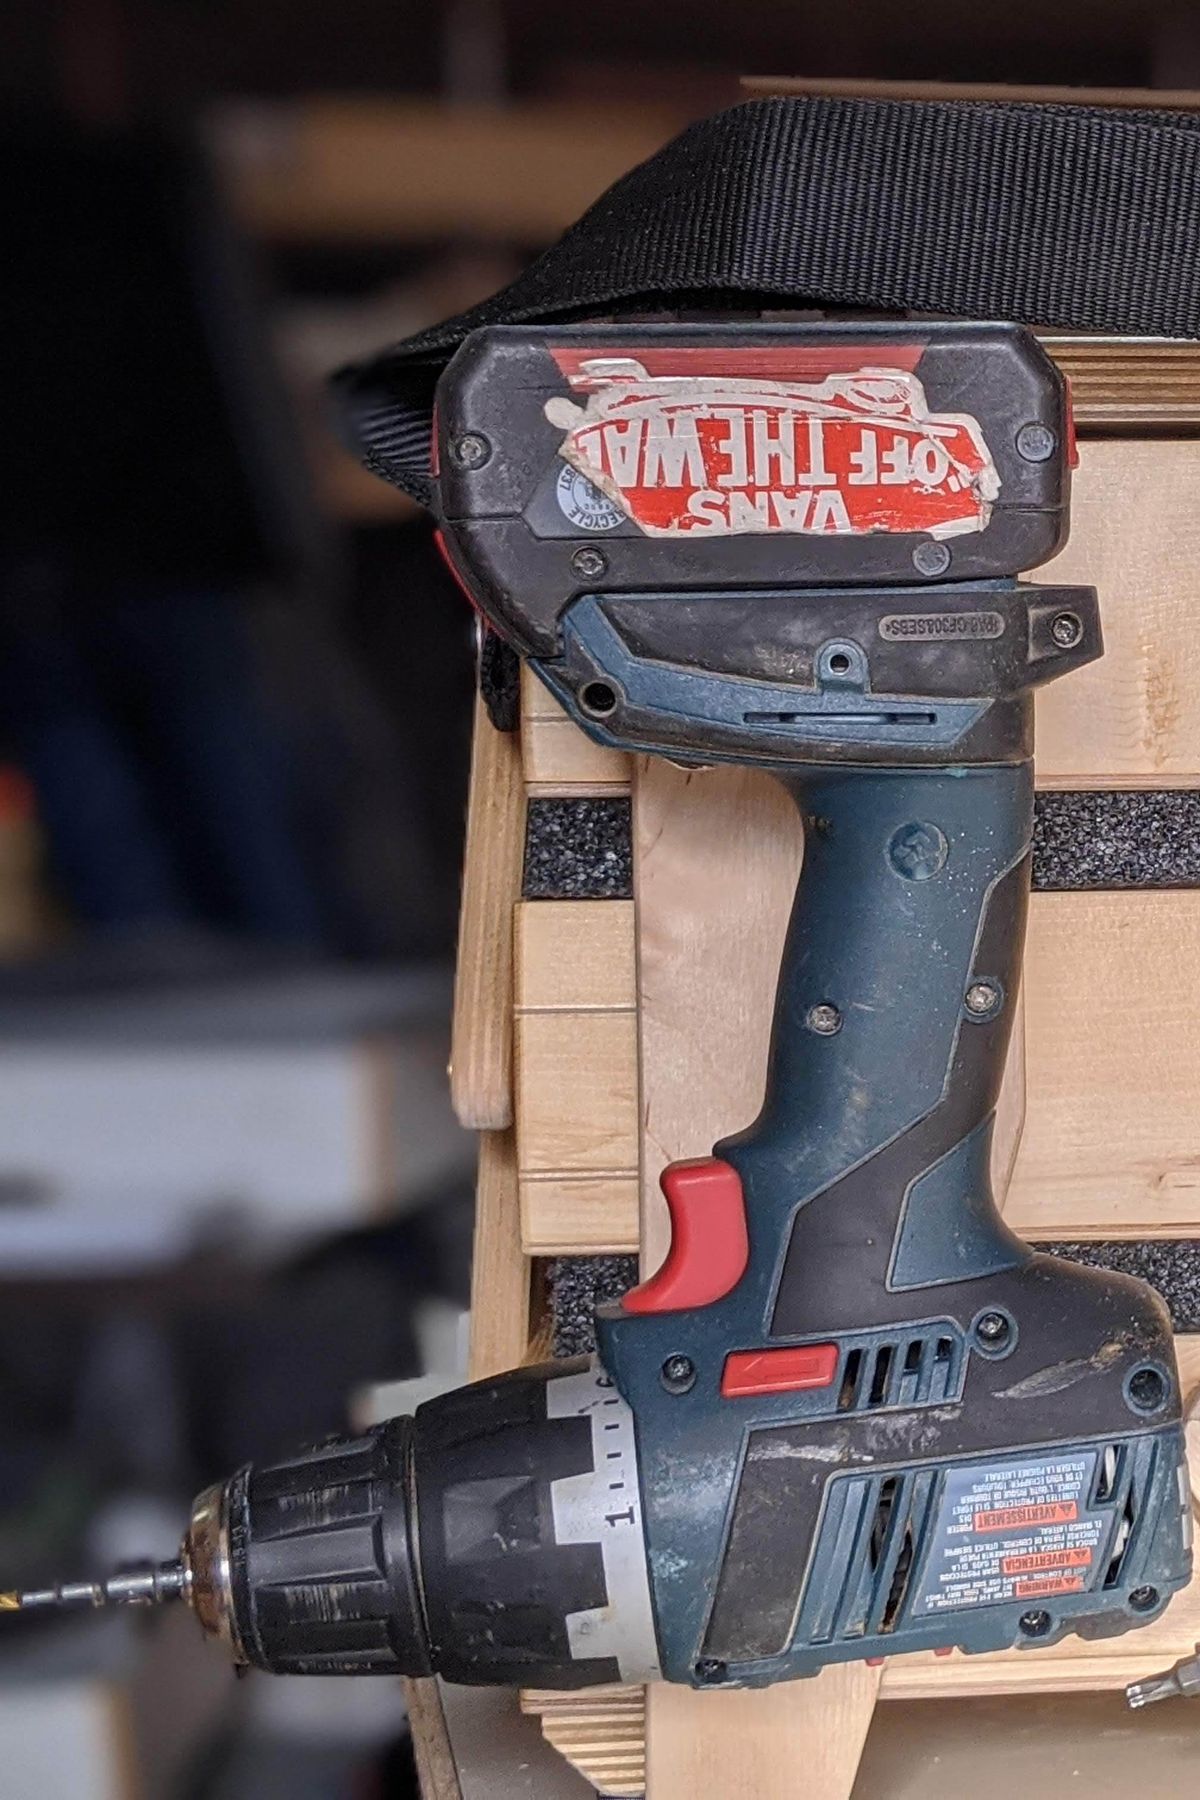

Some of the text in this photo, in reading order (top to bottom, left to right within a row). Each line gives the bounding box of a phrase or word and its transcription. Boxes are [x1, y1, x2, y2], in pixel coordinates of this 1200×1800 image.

[716, 408, 836, 486] THE
[685, 489, 851, 533] VANS
[605, 1506, 635, 1527] 1
[978, 1506, 1055, 1527] AVERTISSEMENT
[1005, 1552, 1070, 1570] ADVERTENCIA
